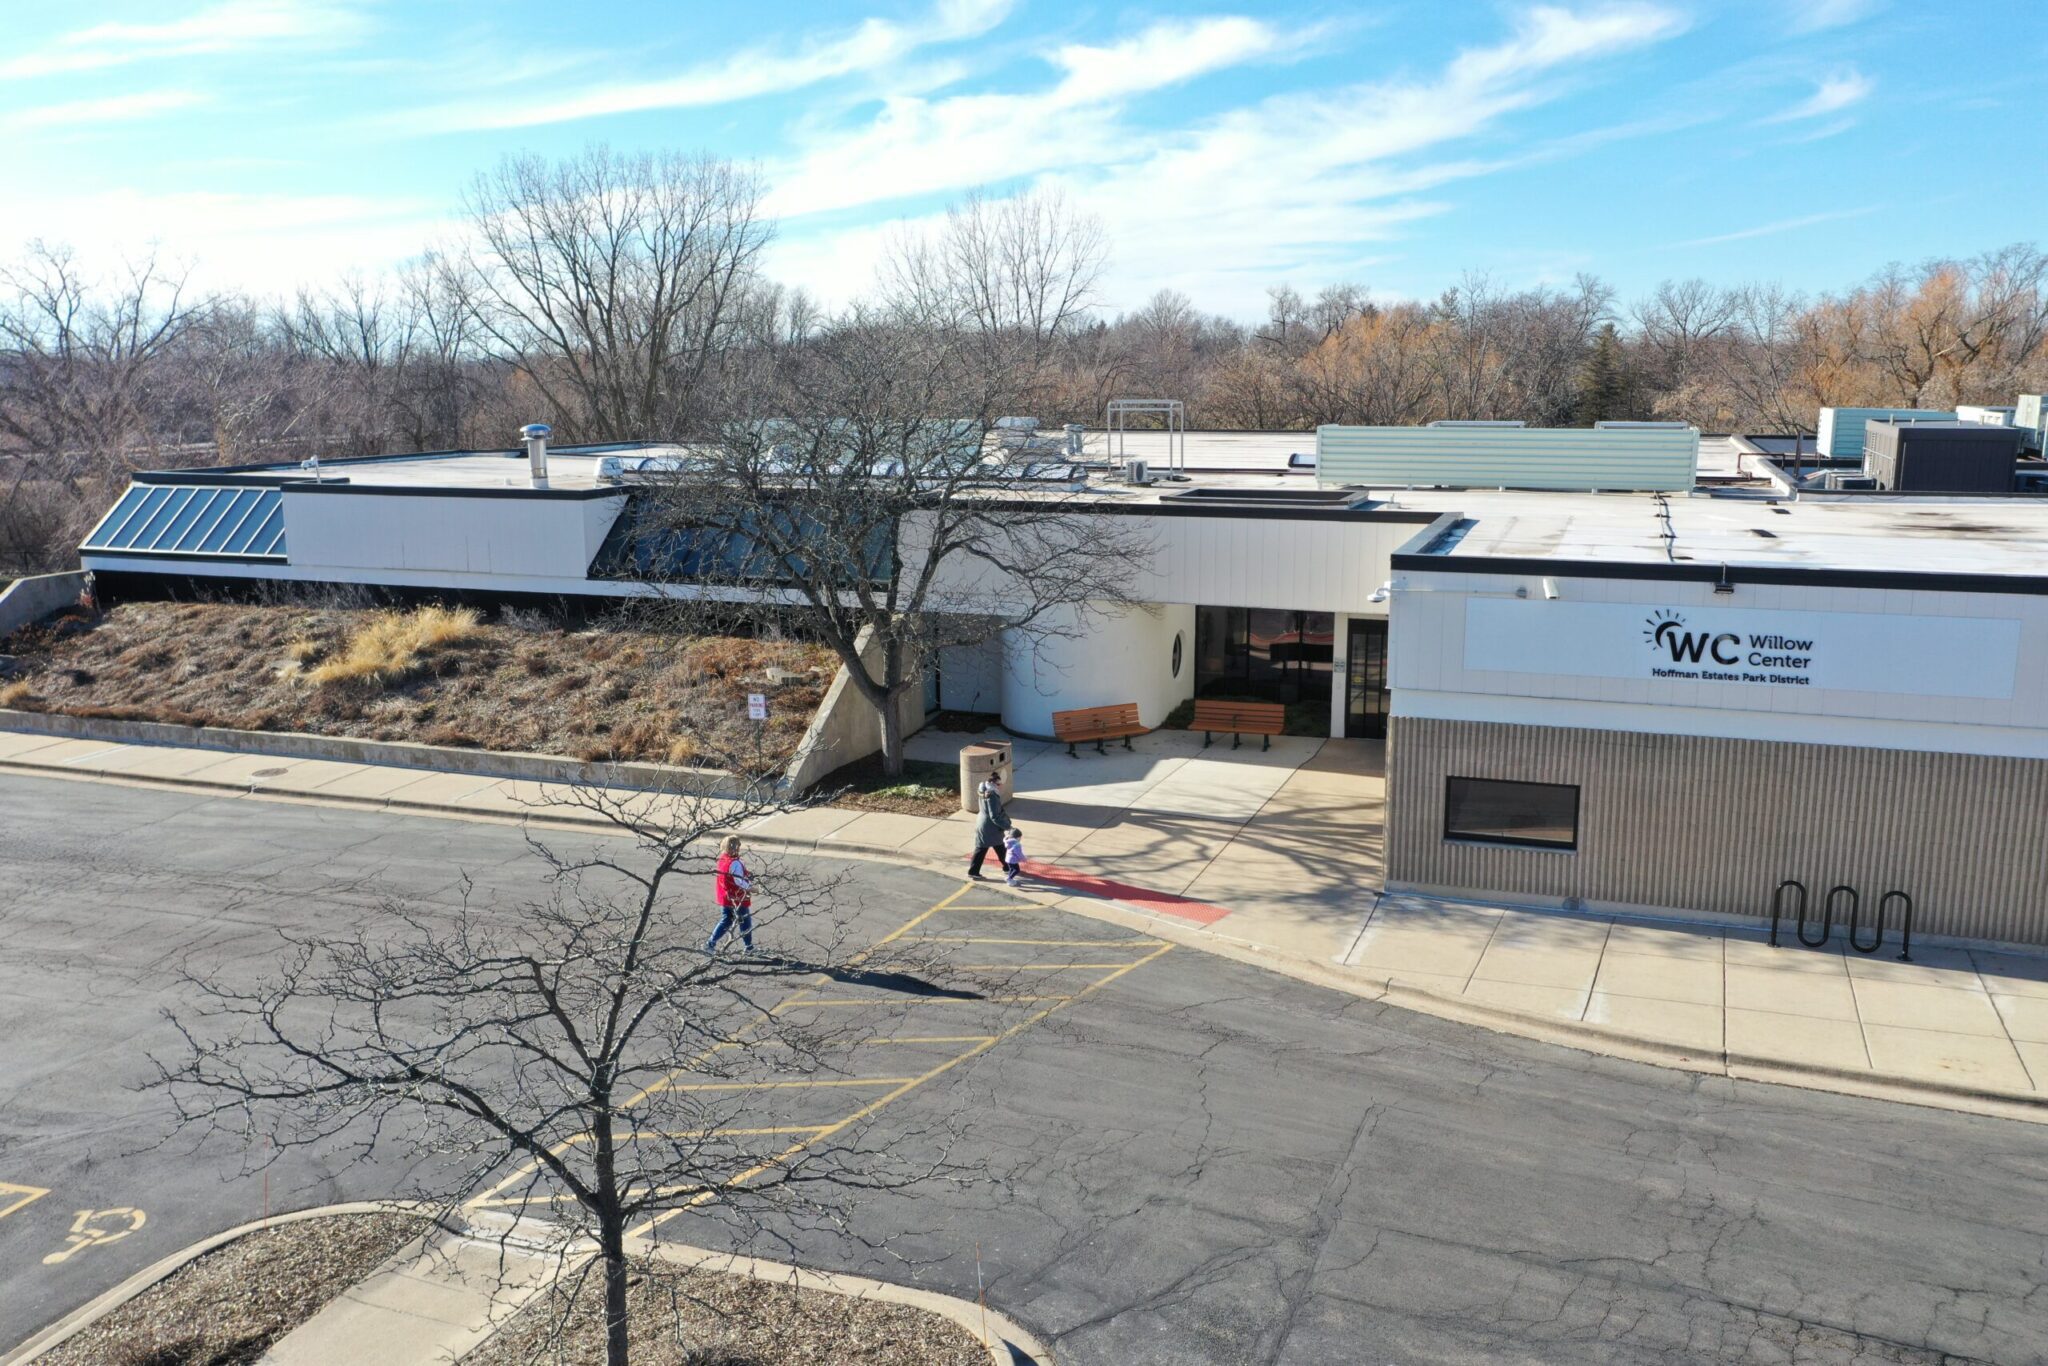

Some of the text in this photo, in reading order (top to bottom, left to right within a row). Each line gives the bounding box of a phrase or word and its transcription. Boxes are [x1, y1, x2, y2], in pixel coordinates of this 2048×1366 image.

[1667, 631, 1740, 665] WC
[1749, 634, 1813, 651] Willow
[1748, 652, 1811, 669] Center
[1652, 668, 1810, 686] Hoffman Estates Park District
